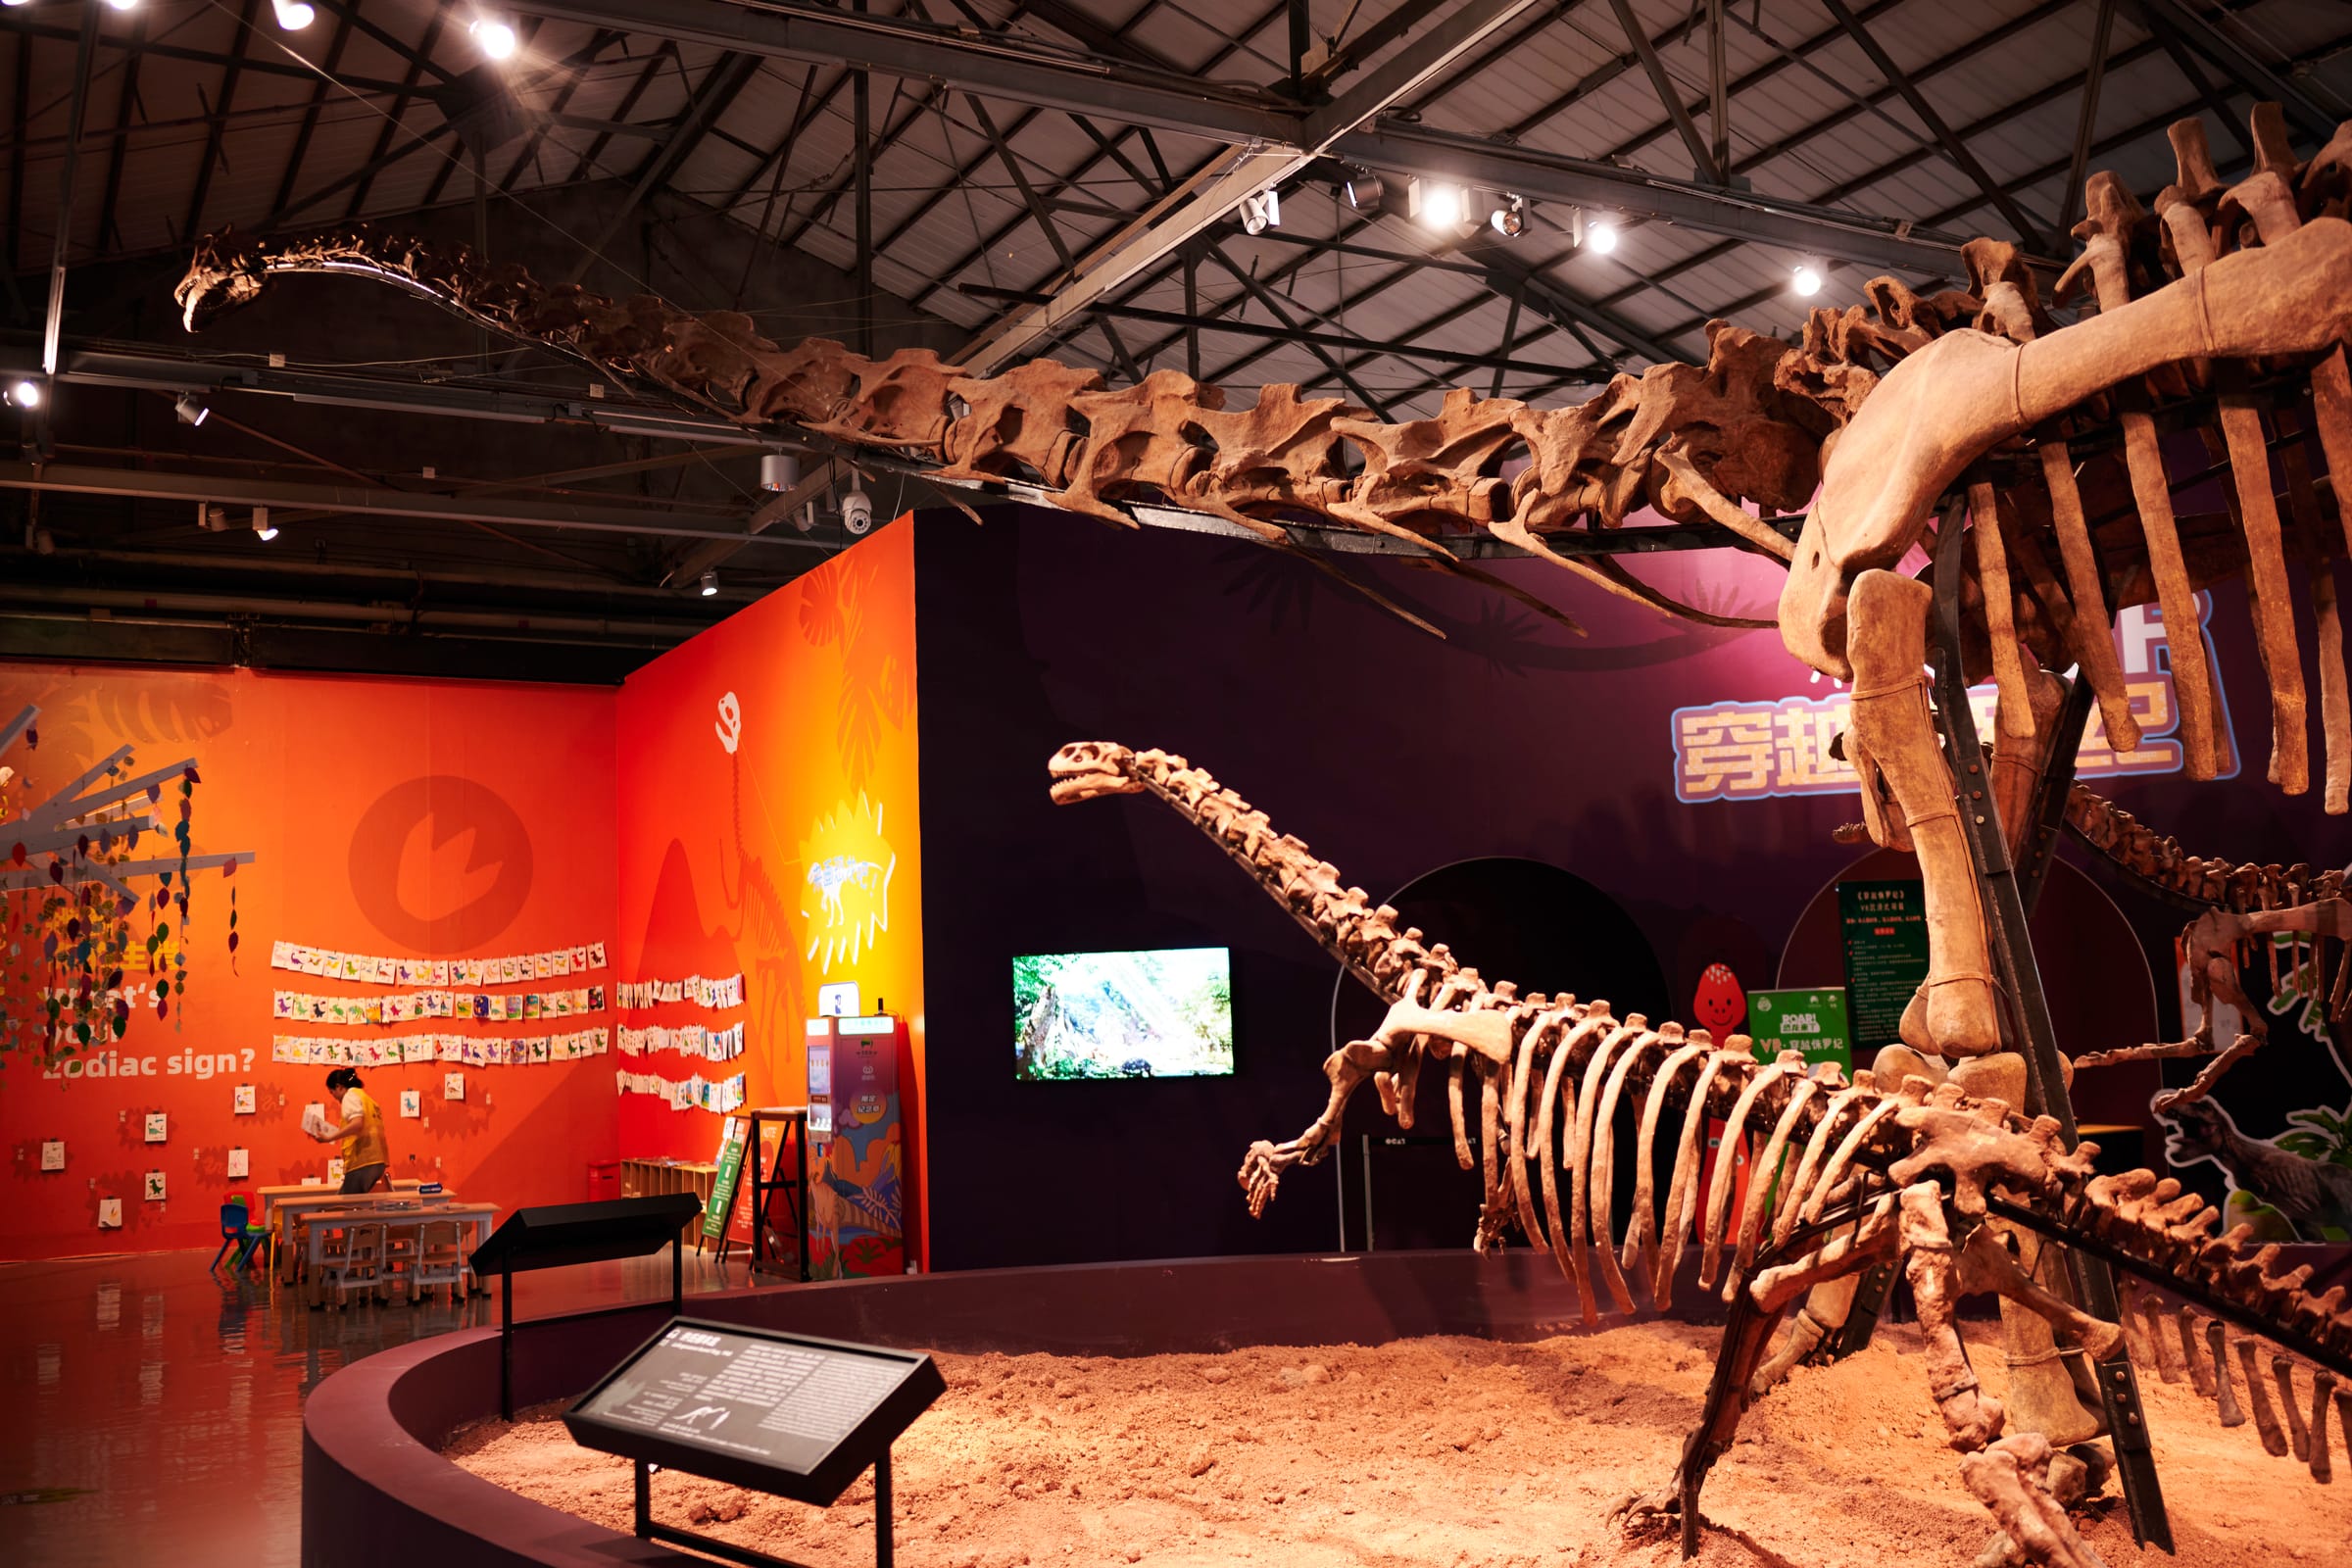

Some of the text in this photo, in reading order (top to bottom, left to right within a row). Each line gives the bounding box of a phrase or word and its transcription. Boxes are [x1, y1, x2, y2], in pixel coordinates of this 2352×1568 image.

[1681, 681, 2174, 796] 穿越纪
[167, 1047, 256, 1080] sign?
